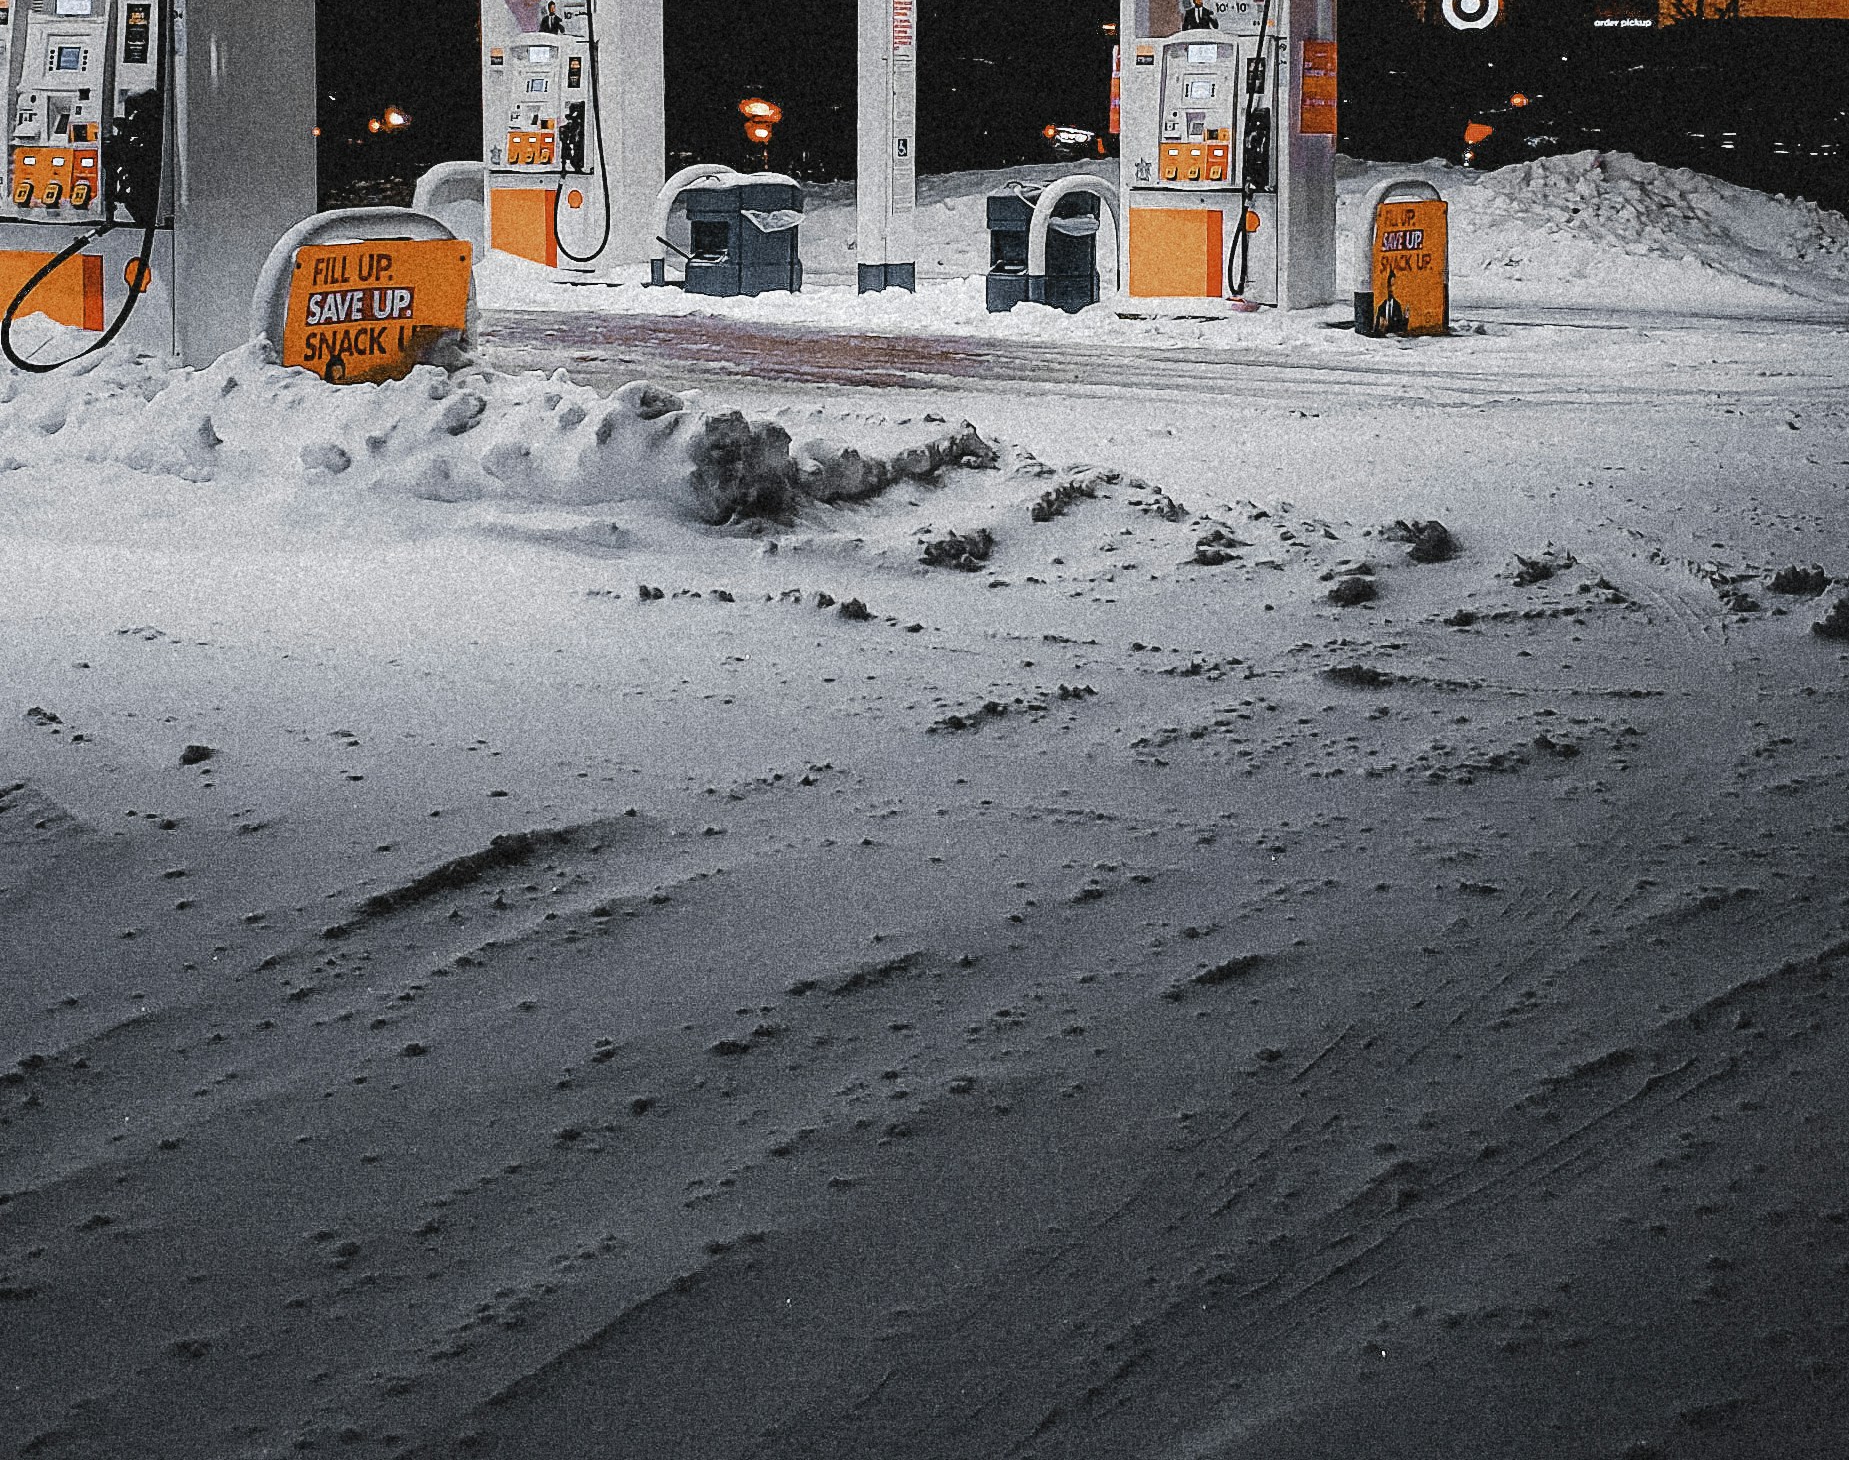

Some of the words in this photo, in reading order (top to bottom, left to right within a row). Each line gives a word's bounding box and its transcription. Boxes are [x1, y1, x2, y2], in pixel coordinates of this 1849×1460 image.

[1593, 18, 1620, 27] order
[1620, 18, 1652, 28] pickup
[312, 254, 350, 286] FILL
[357, 253, 394, 282] UP.
[306, 290, 364, 325] SAVE
[373, 289, 412, 319] UP.
[303, 326, 388, 362] SNACK
